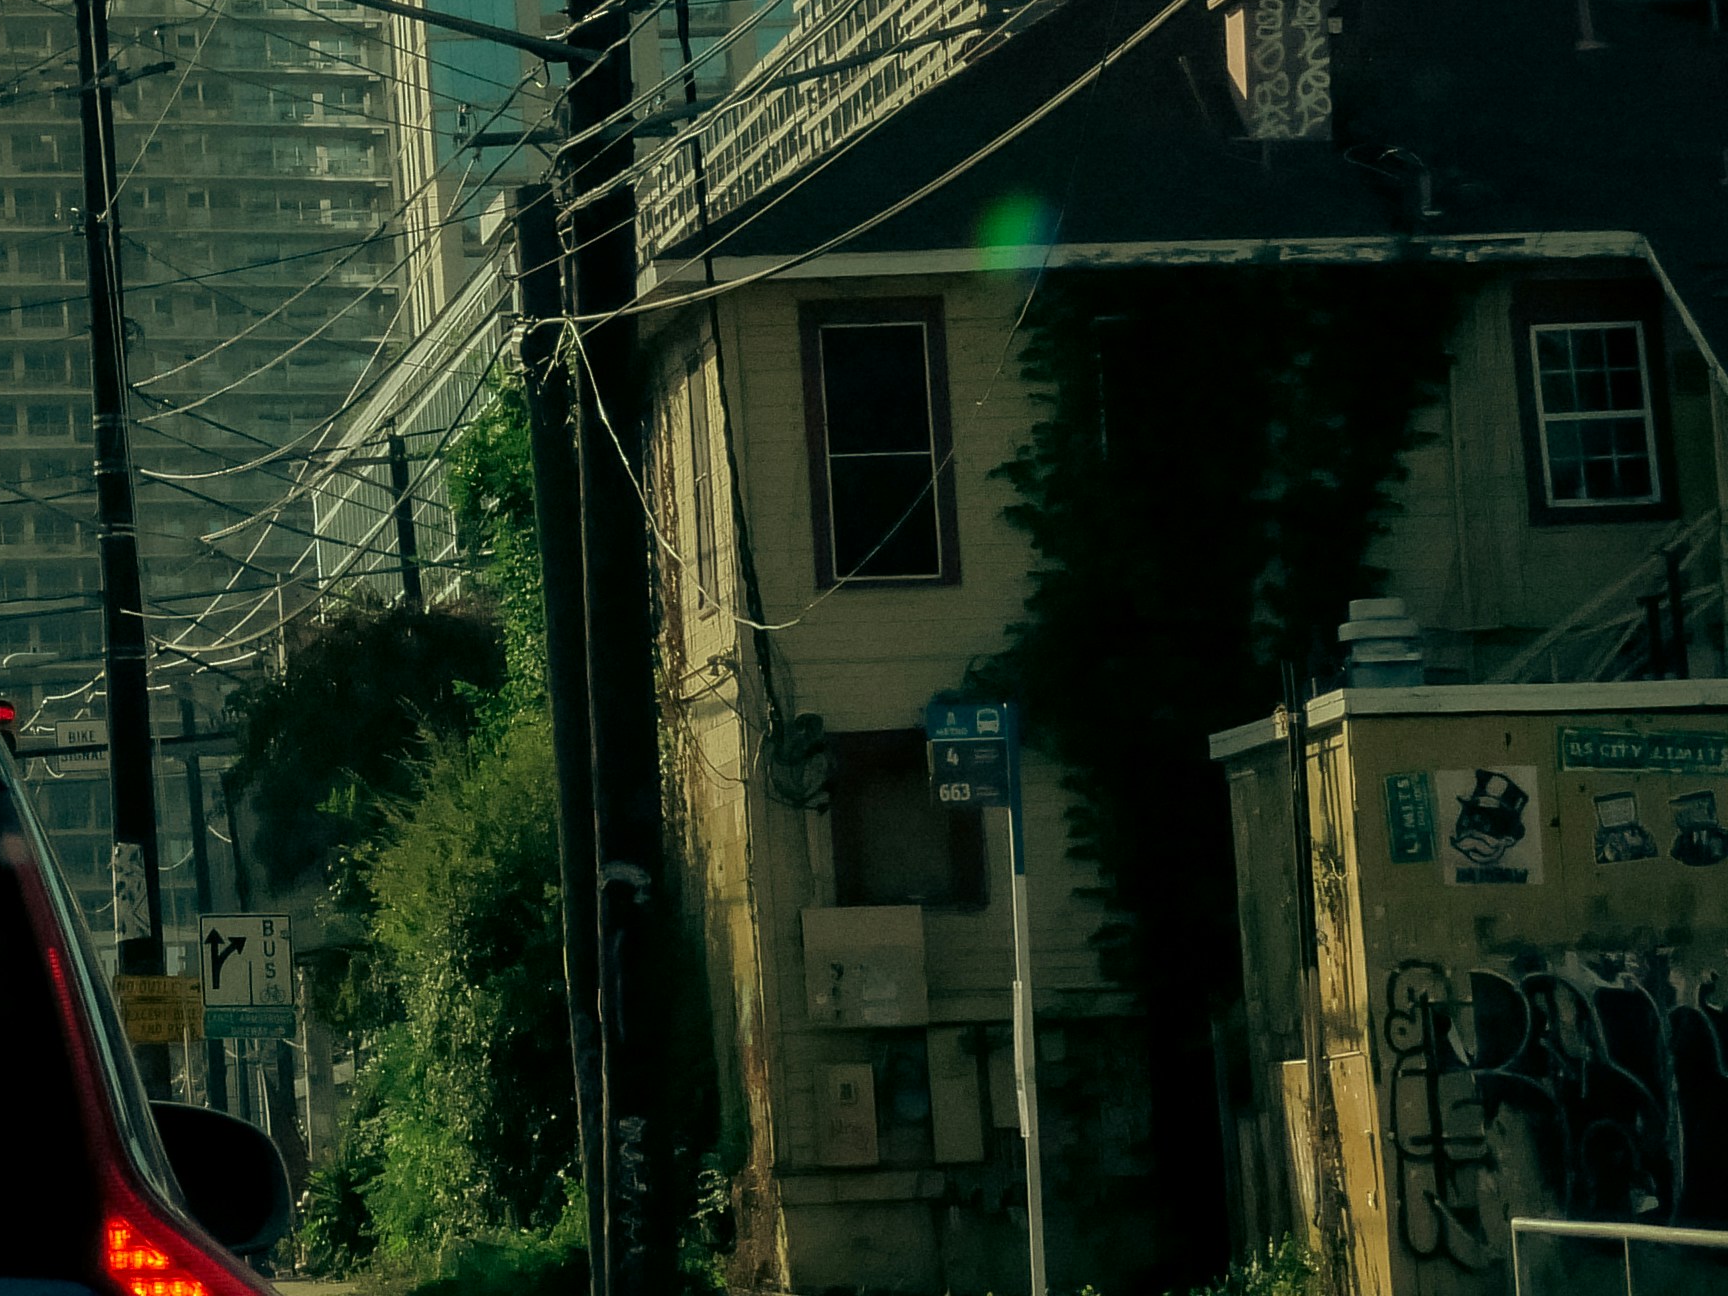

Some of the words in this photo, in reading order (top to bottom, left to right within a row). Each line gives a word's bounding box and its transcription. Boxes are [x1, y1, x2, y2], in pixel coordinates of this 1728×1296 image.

[68, 730, 97, 744] BIKE
[946, 747, 960, 766] 4
[1599, 742, 1642, 758] CITY
[939, 783, 971, 802] 663
[262, 919, 276, 979] BUS
[117, 980, 134, 994] NO
[139, 980, 182, 995] OUTLET
